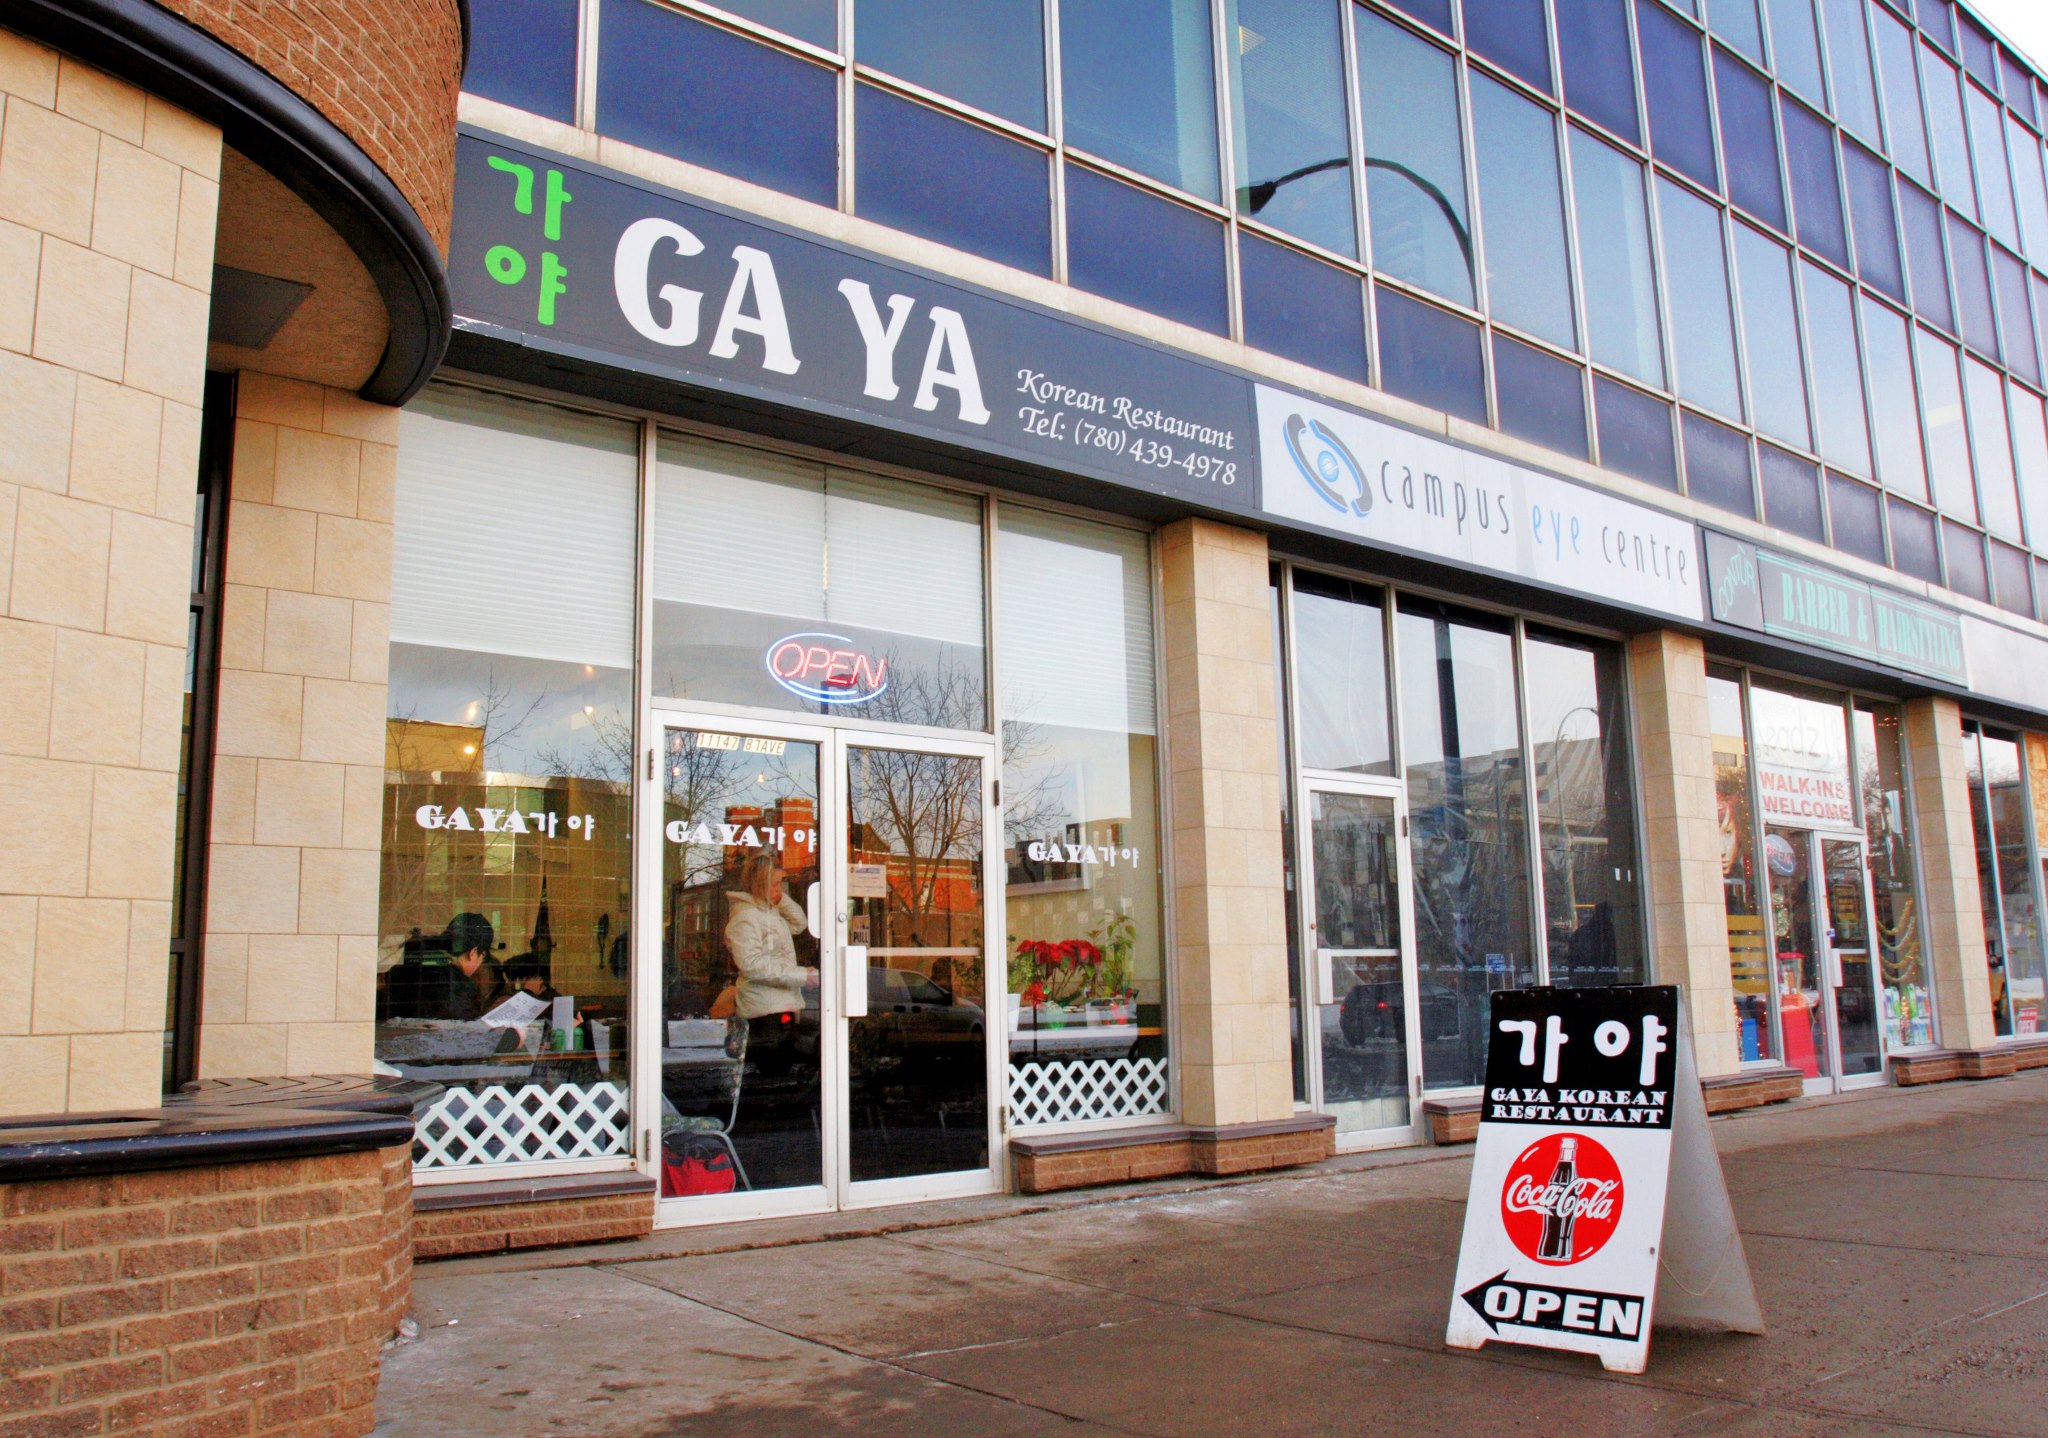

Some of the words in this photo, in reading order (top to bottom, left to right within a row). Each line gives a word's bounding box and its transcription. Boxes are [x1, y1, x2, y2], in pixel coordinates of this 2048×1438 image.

[1017, 369, 1106, 414] Korean
[1112, 397, 1235, 450] Restaurant
[1019, 407, 1065, 440] Tel:
[1074, 418, 1126, 455] (780)
[1129, 438, 1237, 485] 439-4978
[1380, 460, 1510, 535] campus
[1532, 504, 1581, 561] eye
[1602, 524, 1687, 585] centre
[1781, 572, 1850, 638] BARBER
[1877, 604, 1961, 671] HAIRSTYLING
[773, 643, 887, 689] OPEN
[700, 734, 738, 749] 11147
[1760, 771, 1845, 800] WALK-INS
[415, 804, 530, 833] GAYA
[1762, 795, 1851, 821] WELCOME
[666, 820, 762, 847] GAYA
[1028, 841, 1099, 864] GAYA
[853, 930, 869, 943] PULL
[1491, 1087, 1550, 1103] GAYA
[1558, 1089, 1667, 1106] KOREAN
[1491, 1104, 1664, 1124] RESTAURANT
[1484, 1285, 1640, 1336] OPEN
